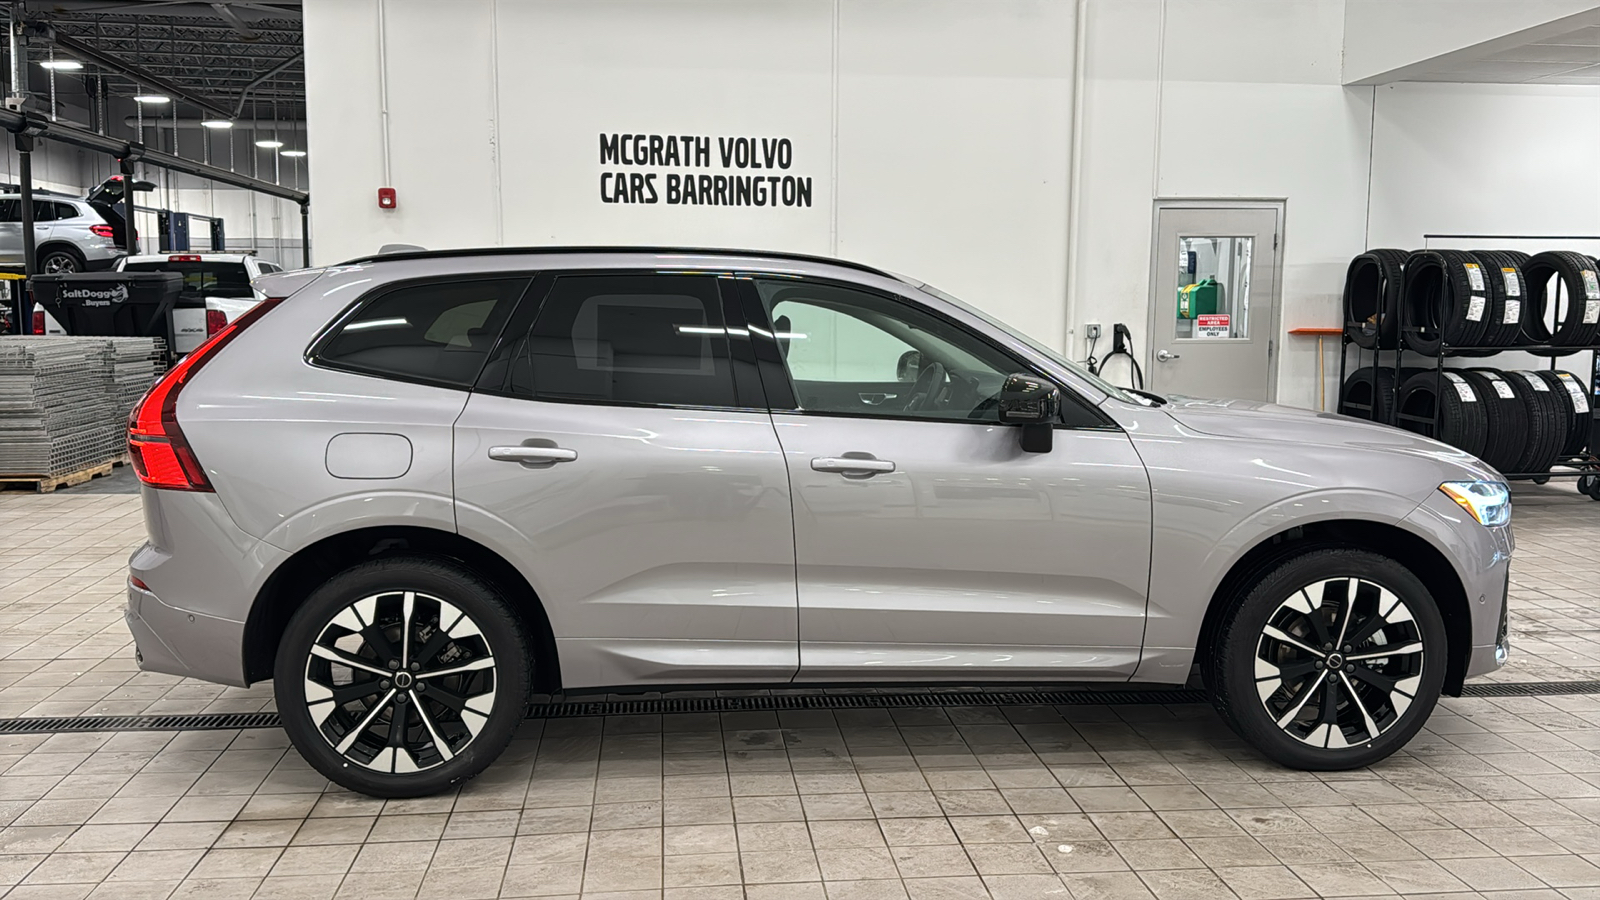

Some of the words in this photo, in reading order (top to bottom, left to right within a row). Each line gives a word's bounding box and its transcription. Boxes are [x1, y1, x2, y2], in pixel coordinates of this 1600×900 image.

[599, 133, 710, 167] MCGRATH
[718, 137, 792, 169] VOLVO
[600, 173, 658, 204] CARS
[666, 174, 812, 207] BARRINGTON
[62, 289, 111, 299] SaltDogg
